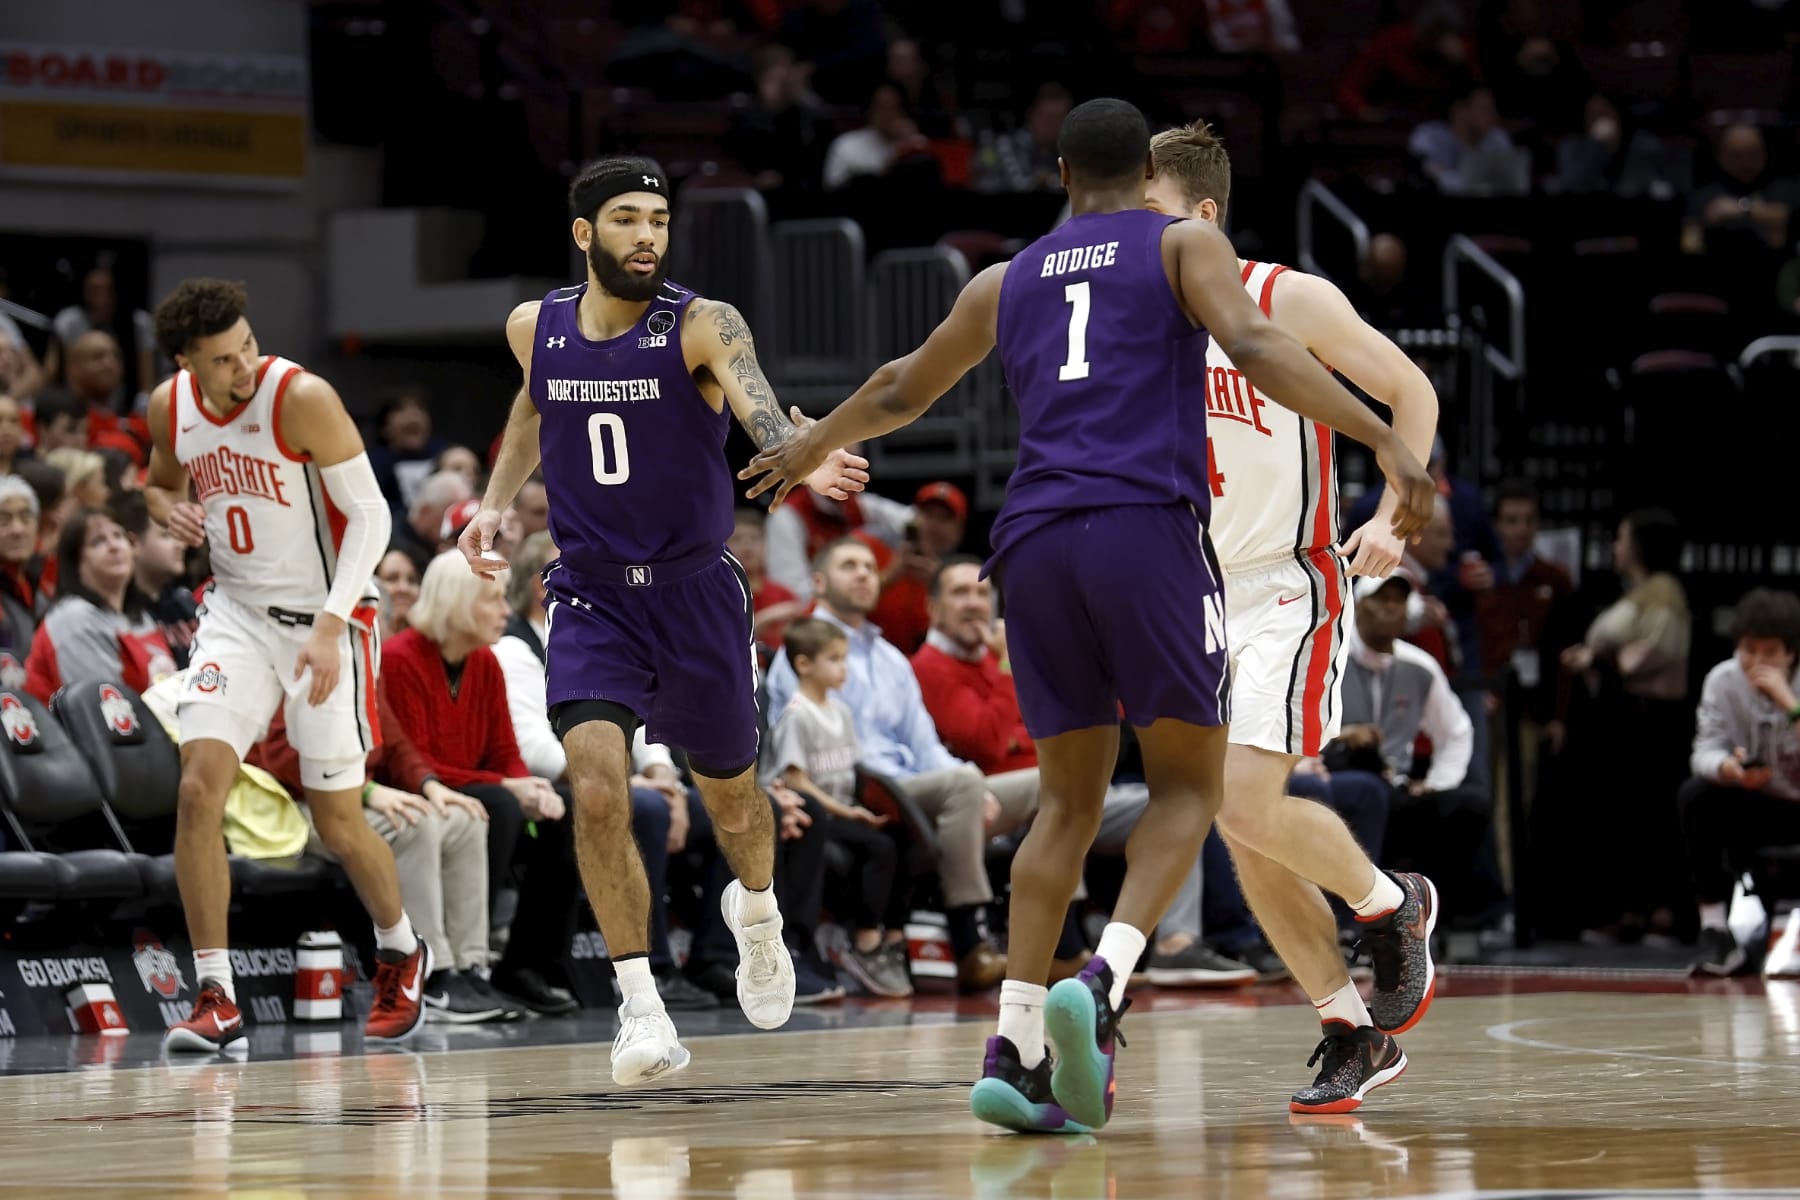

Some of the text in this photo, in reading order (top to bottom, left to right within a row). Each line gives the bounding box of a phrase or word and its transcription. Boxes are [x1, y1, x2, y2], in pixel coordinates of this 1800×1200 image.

[1040, 241, 1119, 278] AUDIGE
[1058, 281, 1091, 381] 1
[547, 378, 661, 402] NORTHWESTERN
[588, 413, 630, 486] 0
[226, 506, 255, 554] 0
[632, 567, 645, 584] N
[1202, 591, 1227, 655] N
[17, 959, 49, 987] GO
